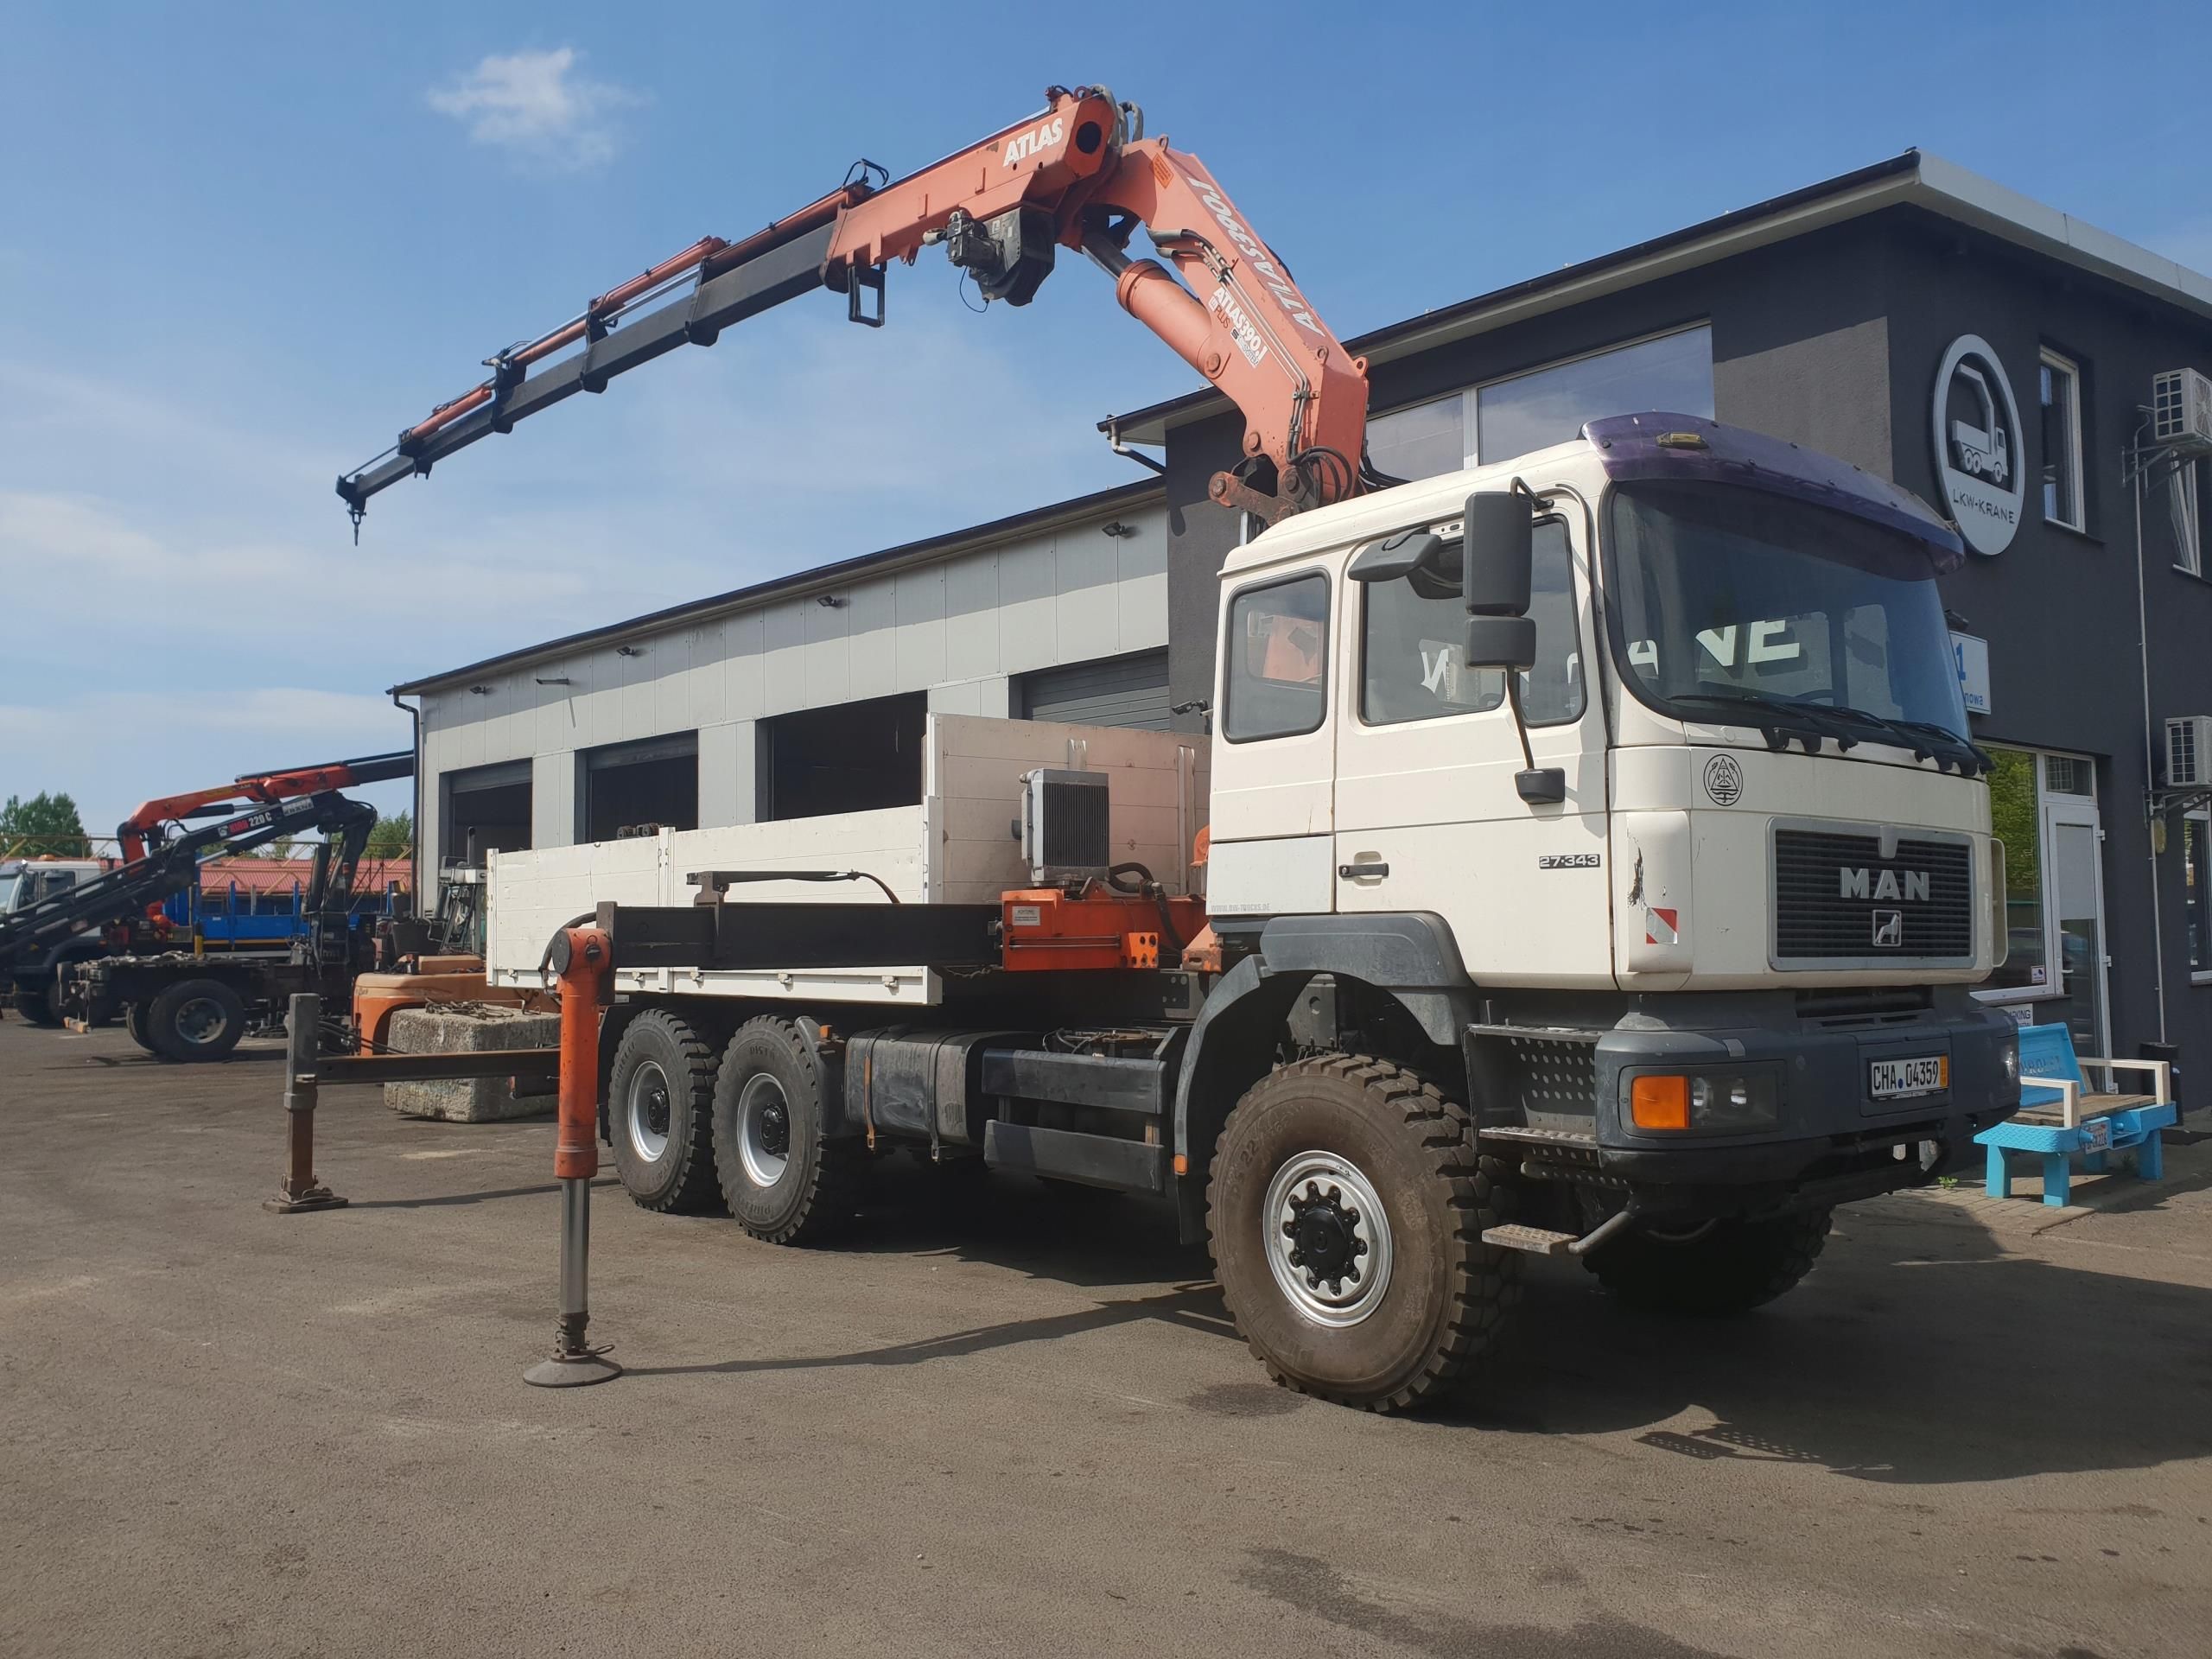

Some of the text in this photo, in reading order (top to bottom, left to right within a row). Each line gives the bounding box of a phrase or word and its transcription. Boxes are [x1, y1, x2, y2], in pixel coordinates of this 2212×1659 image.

[1002, 118, 1063, 167] ATLAS
[1214, 304, 1230, 328] PLUS
[1953, 488, 2015, 524] LKW-KRANE
[249, 813, 265, 827] 220
[1840, 867, 1929, 901] MAN
[1873, 1059, 1939, 1090] CHA 04359
